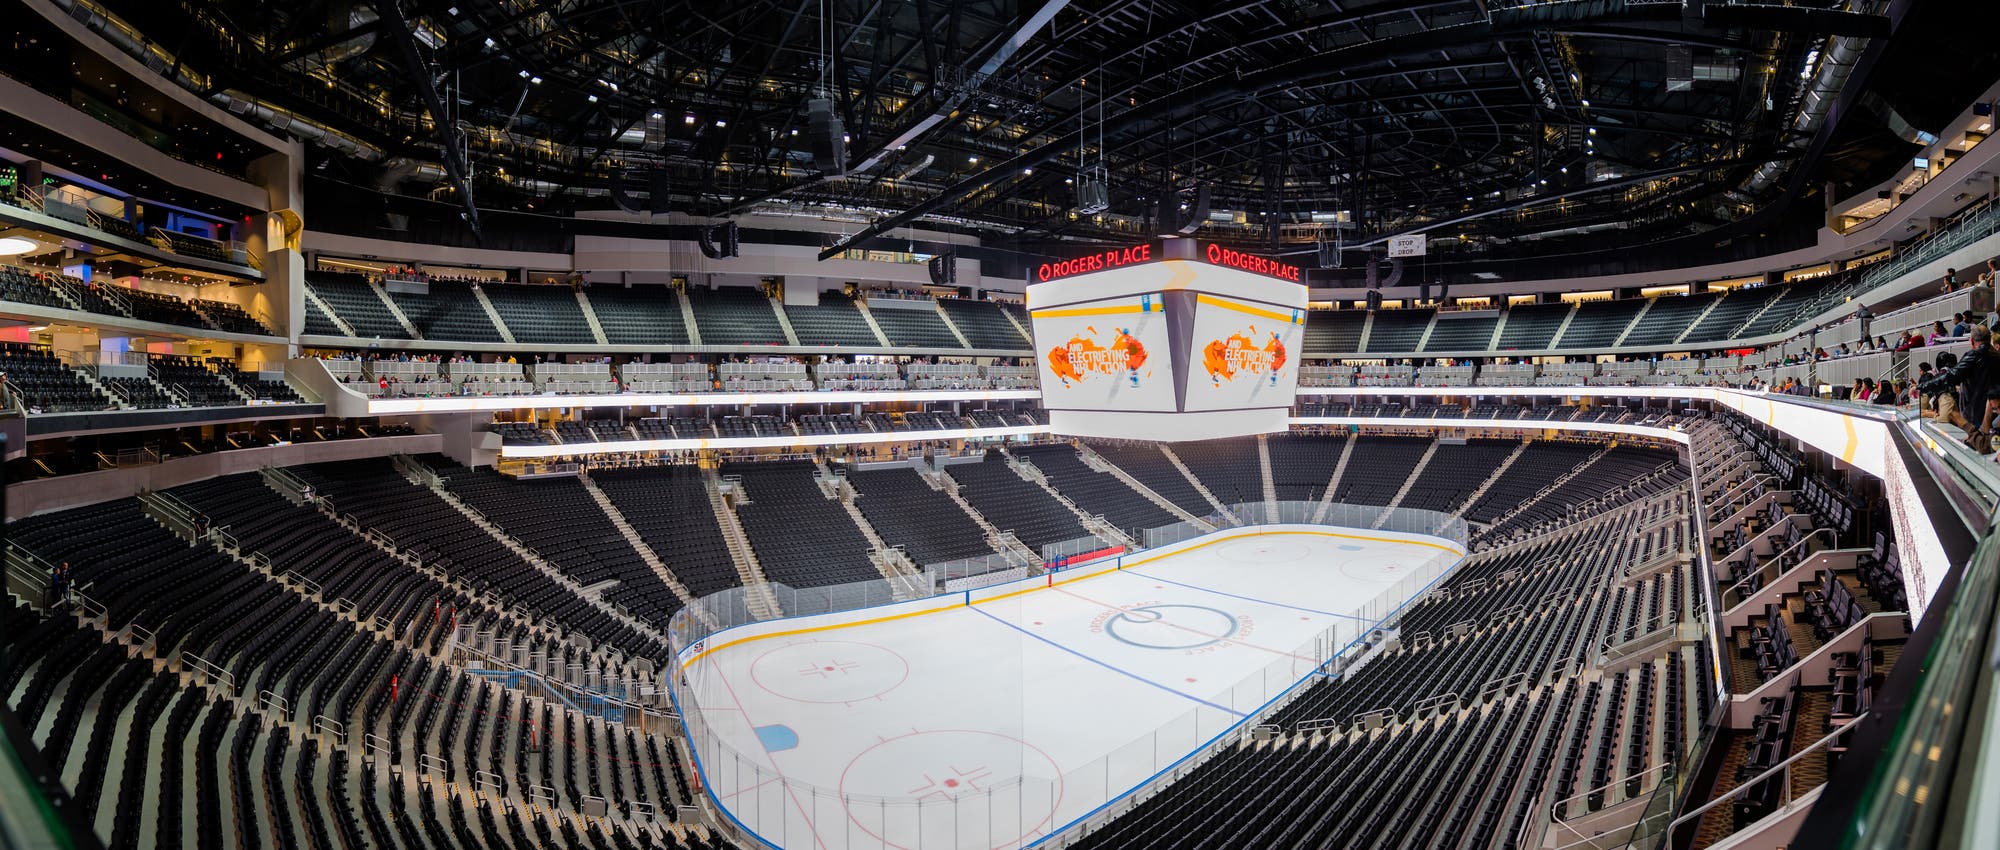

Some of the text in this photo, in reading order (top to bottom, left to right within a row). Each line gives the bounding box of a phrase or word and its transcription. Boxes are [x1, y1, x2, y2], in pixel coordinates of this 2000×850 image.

[1053, 244, 1151, 278] ROGERS PLACE
[1222, 249, 1299, 281] ROGERS PLACE
[1069, 343, 1083, 352] AND
[1228, 340, 1241, 349] AND
[1068, 349, 1130, 363] ELECTRIFYING
[1225, 348, 1275, 362] ELECTRIFYING
[1093, 360, 1127, 373] ACTION
